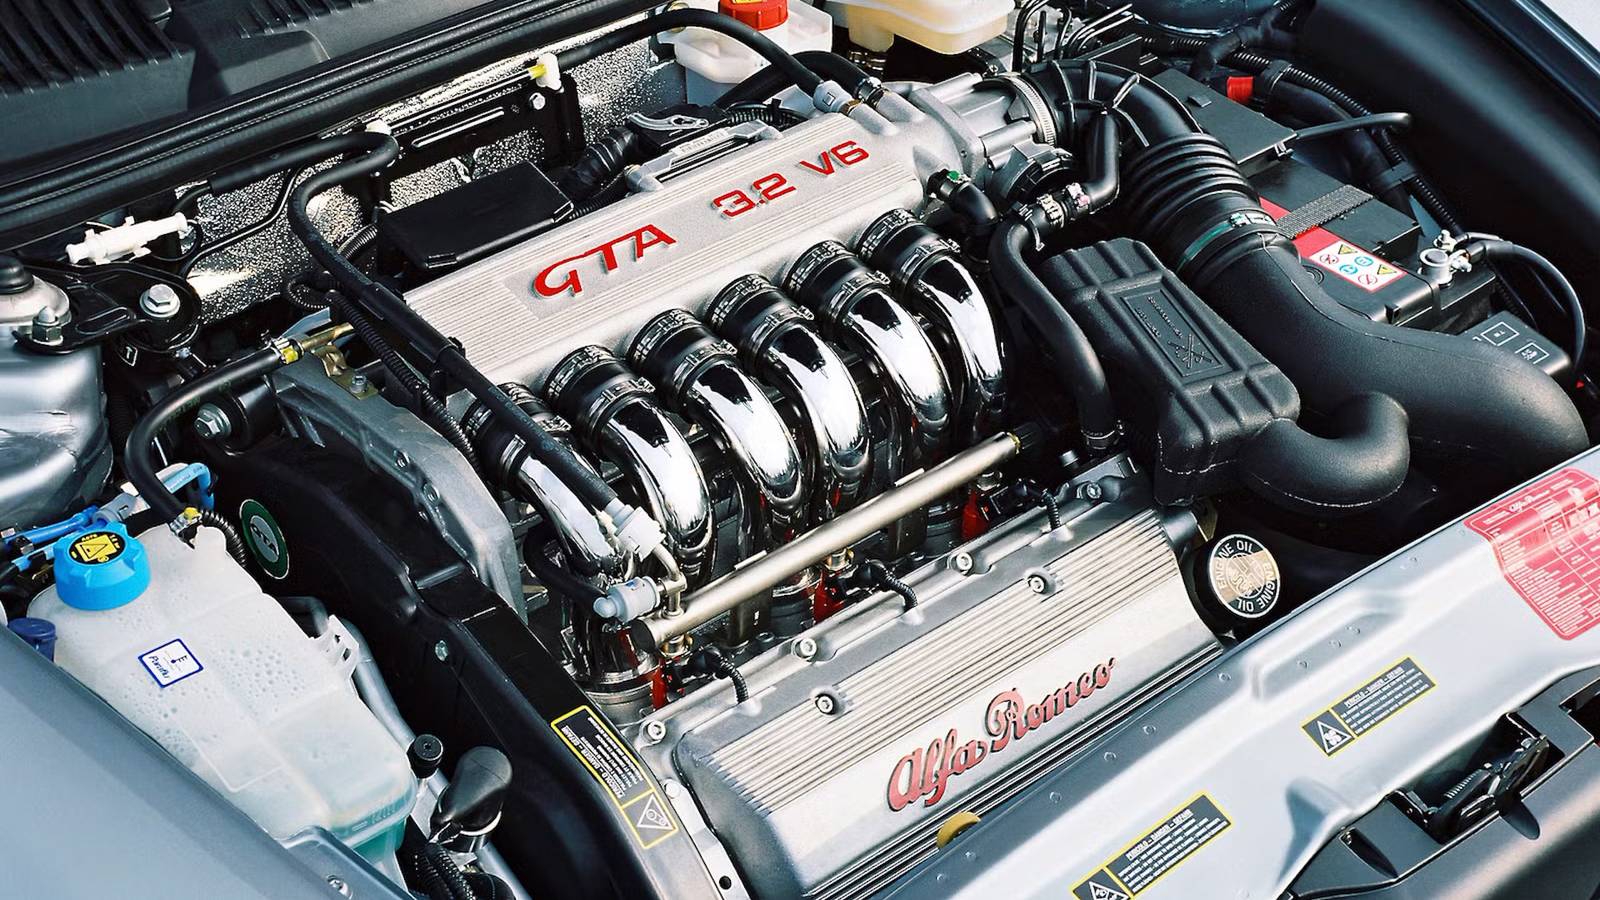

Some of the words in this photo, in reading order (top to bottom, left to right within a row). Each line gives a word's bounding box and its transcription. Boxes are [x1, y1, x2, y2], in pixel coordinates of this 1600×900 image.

[532, 223, 677, 298] GTA
[711, 172, 797, 218] 3.2
[799, 140, 870, 177] V6
[1235, 539, 1253, 554] OIL
[1235, 596, 1254, 612] OIL
[887, 728, 988, 812] Alfa
[984, 657, 1116, 753] Romeo
